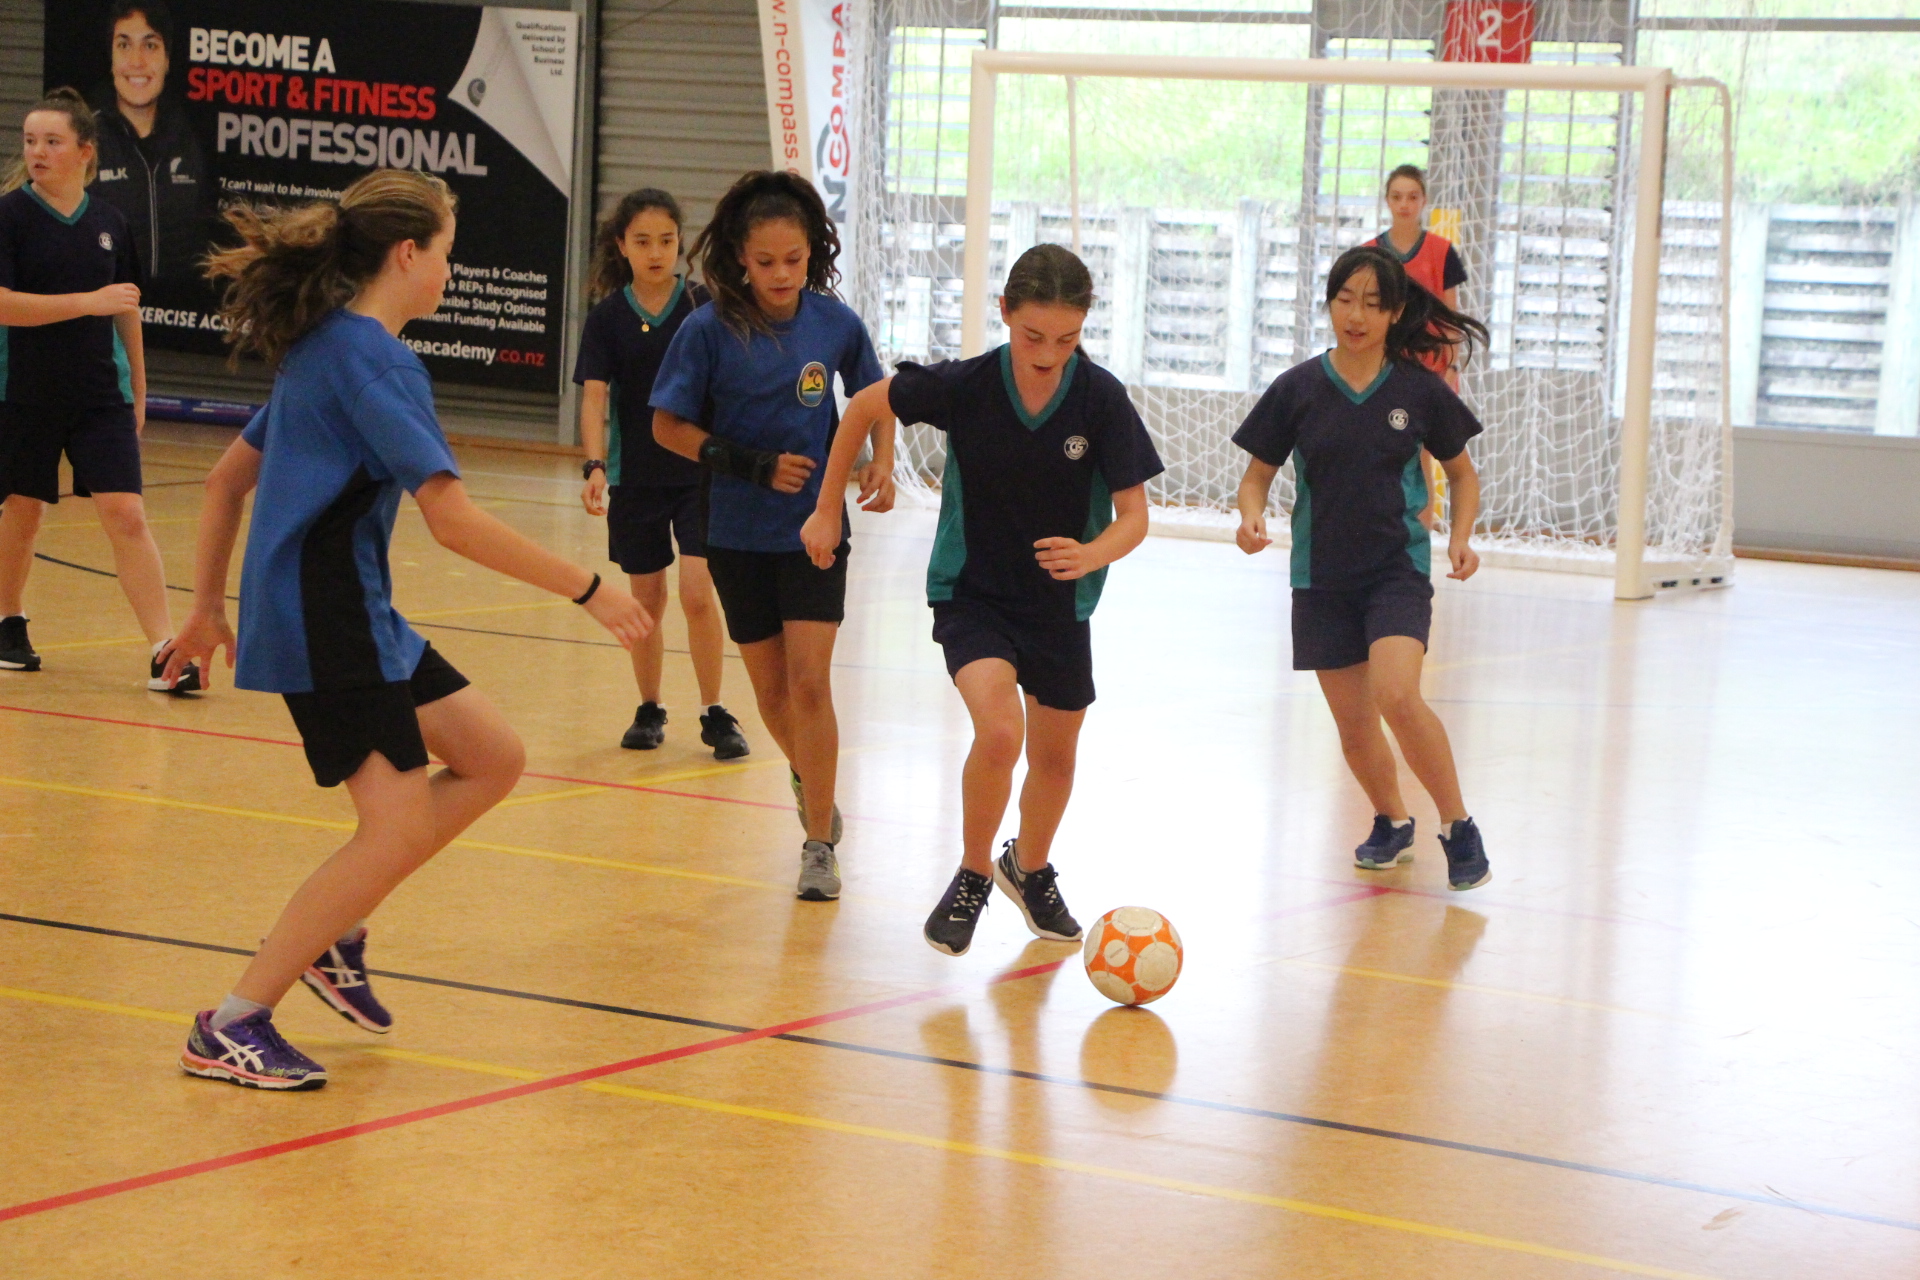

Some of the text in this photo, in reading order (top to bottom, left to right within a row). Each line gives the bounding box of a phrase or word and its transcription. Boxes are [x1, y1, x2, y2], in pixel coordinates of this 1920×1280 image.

[515, 21, 566, 31] Qualifications
[1477, 8, 1502, 46] 2
[531, 44, 565, 54] School of
[556, 35, 565, 44] by
[189, 27, 336, 74] BECOME A
[187, 68, 436, 120] SPORT & FITNESS
[217, 111, 488, 177] PROFESSIONAL
[227, 179, 251, 188] can't
[254, 182, 275, 192] wait
[277, 184, 288, 194] to
[290, 184, 303, 196] be
[453, 263, 547, 284] Players & Coaches
[448, 279, 547, 300] & REPs Recognised
[472, 299, 501, 313] Study
[503, 301, 546, 317] Options
[454, 312, 496, 331] Funding
[498, 317, 546, 333] Available
